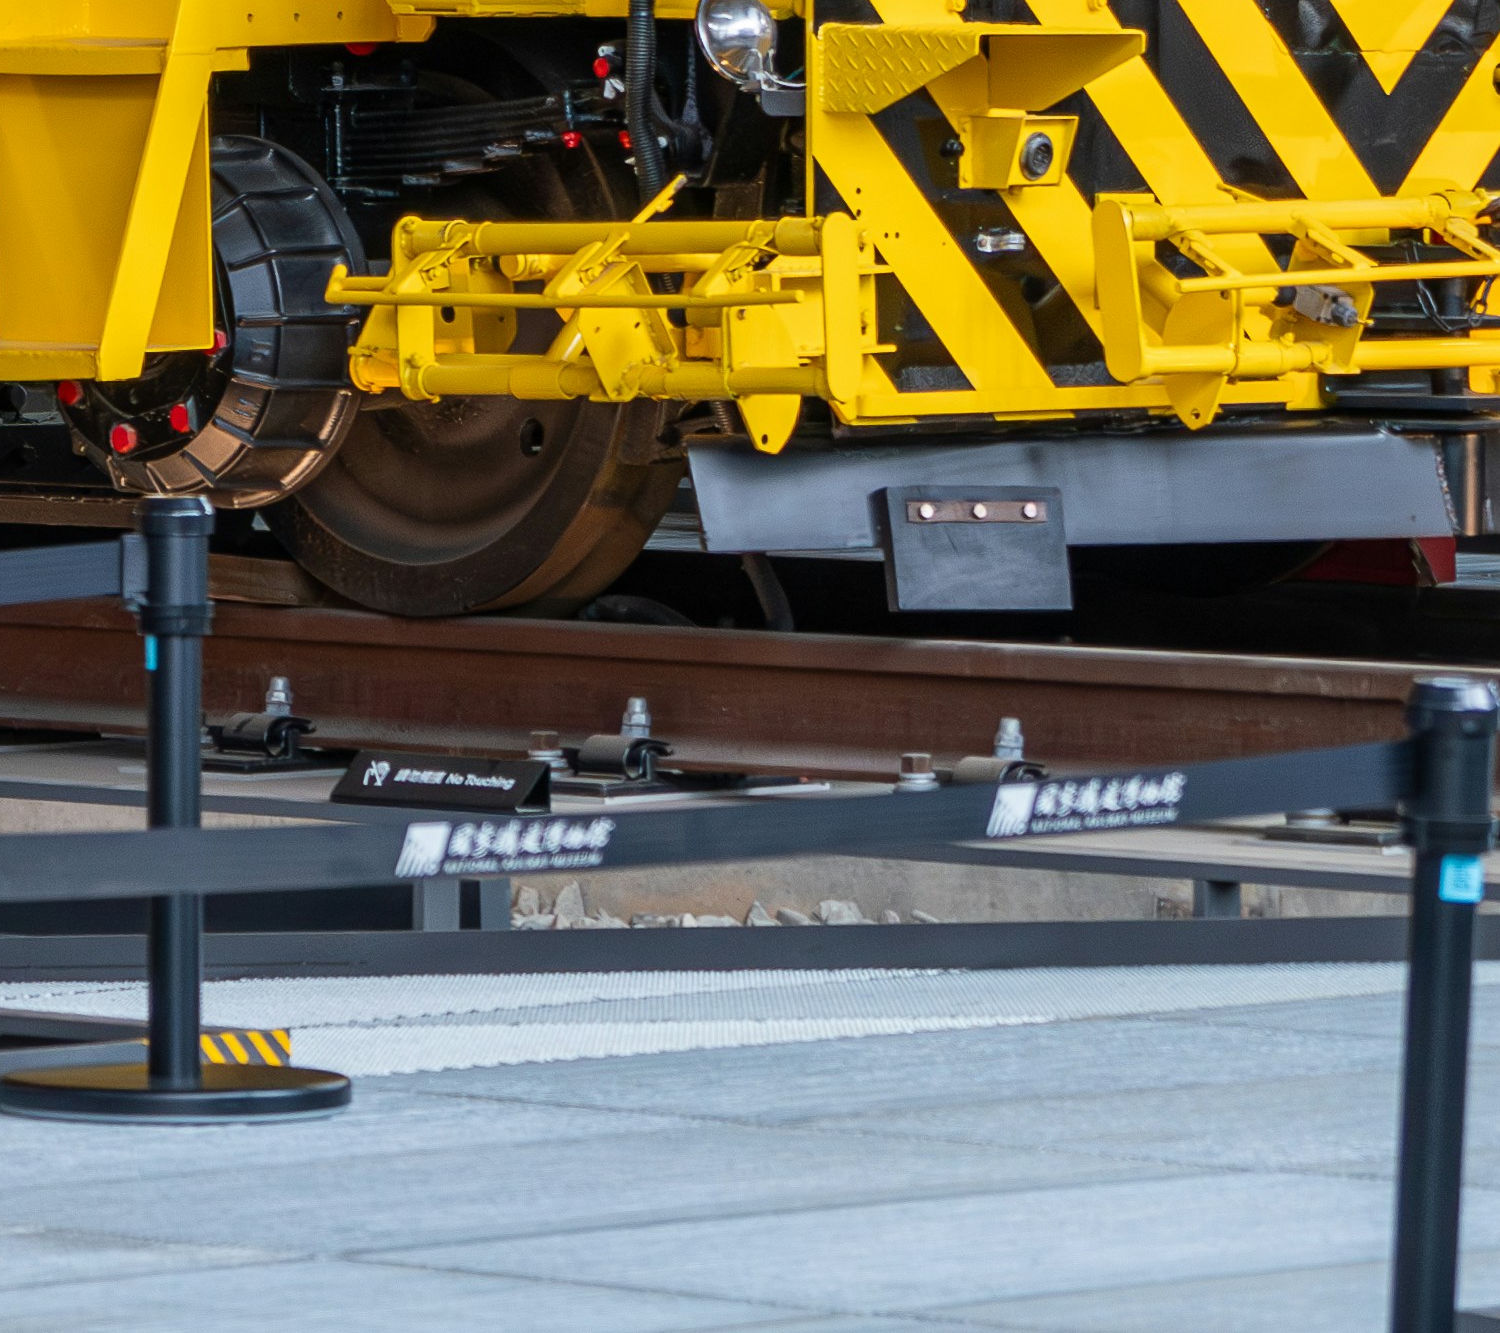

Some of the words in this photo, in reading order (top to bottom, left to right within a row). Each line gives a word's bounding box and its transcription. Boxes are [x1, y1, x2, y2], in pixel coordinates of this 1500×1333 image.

[445, 772, 464, 785] No
[464, 773, 516, 790] Touching
[1034, 772, 1187, 817] 國家鐵道博物館
[449, 816, 616, 858] 國家鐵道博物館
